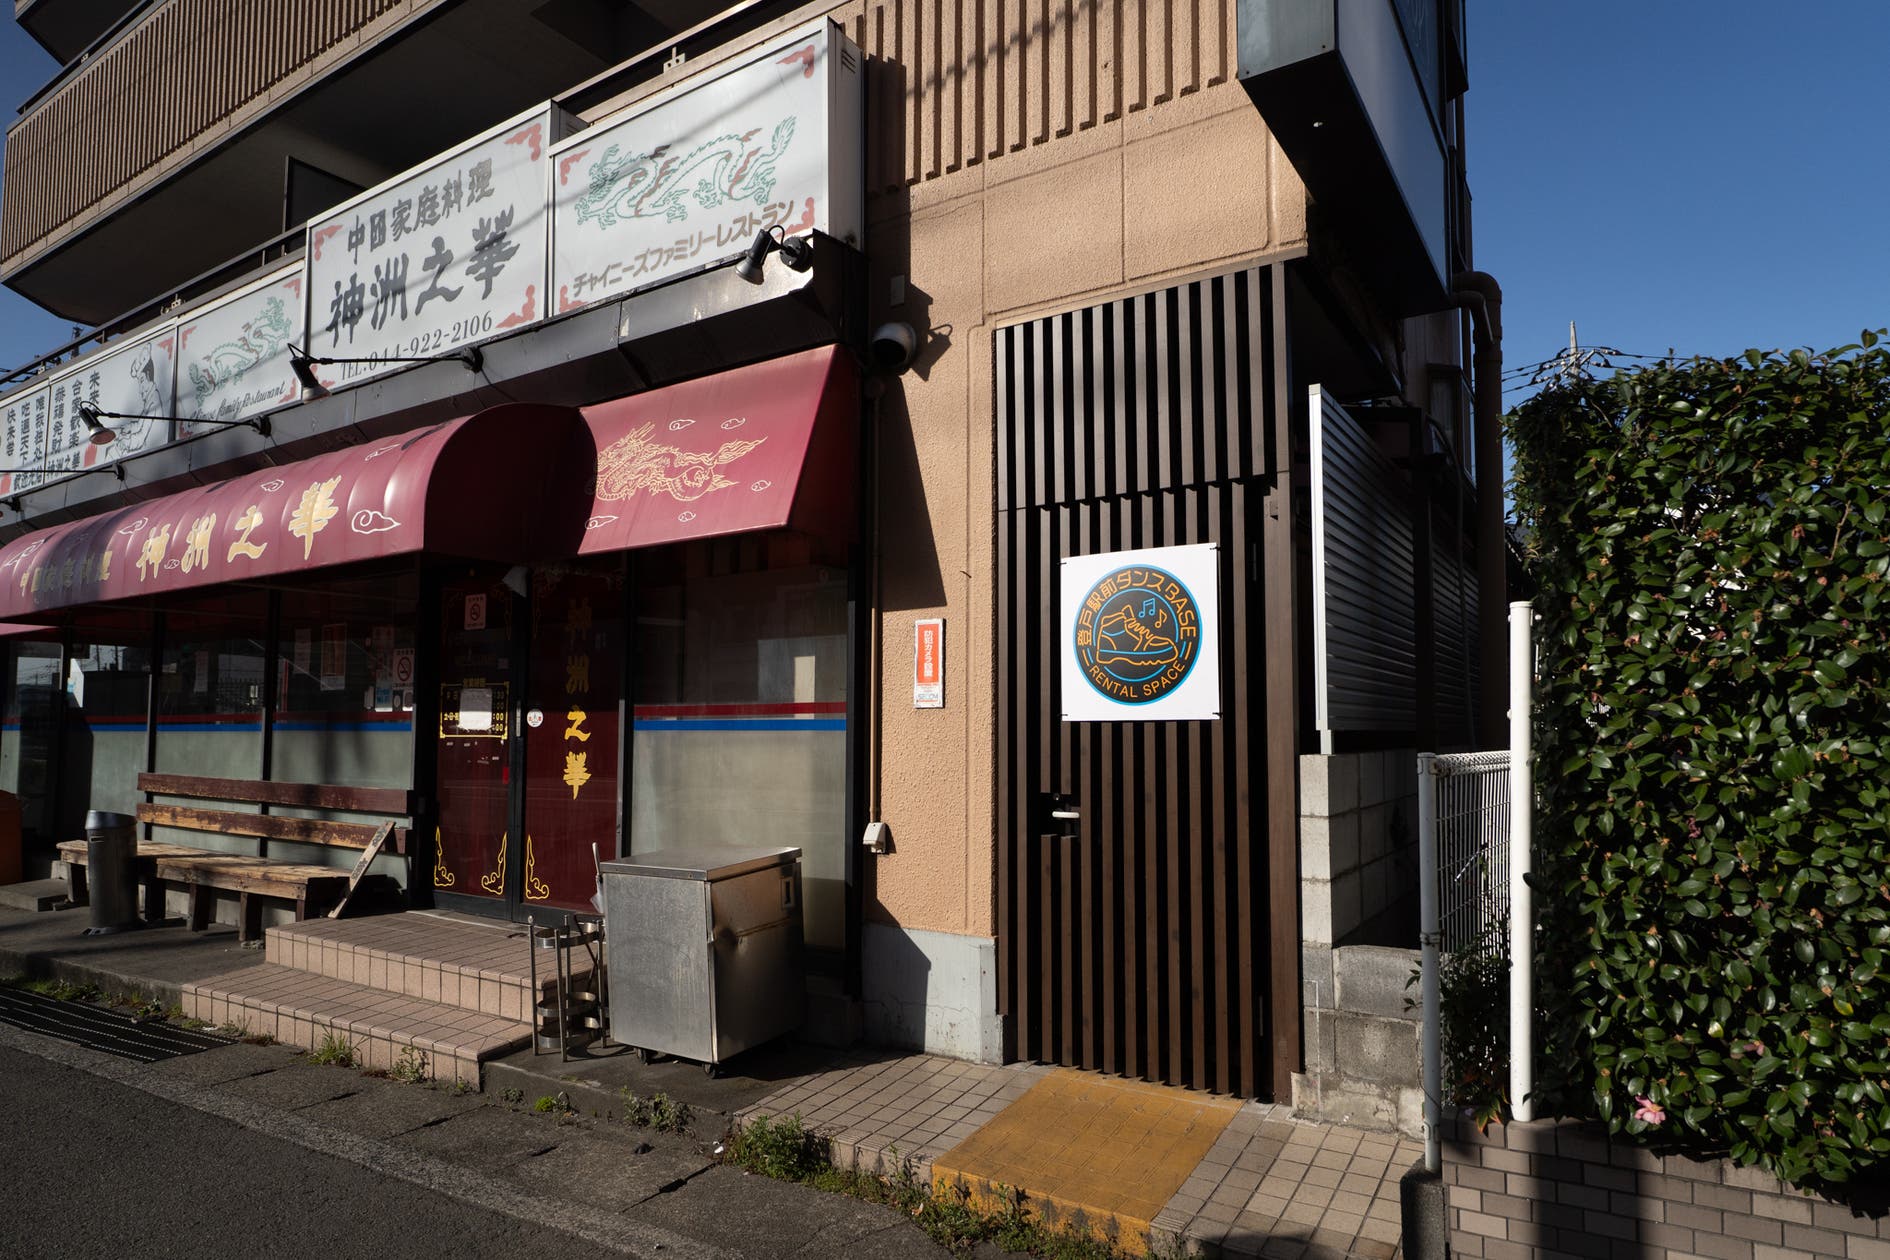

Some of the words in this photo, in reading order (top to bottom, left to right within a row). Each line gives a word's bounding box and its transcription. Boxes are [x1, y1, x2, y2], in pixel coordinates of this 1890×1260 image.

[573, 200, 794, 297] チャイニーズファミリーレストラン
[1090, 664, 1138, 698] RENTAL
[1142, 660, 1185, 697] SPACE
